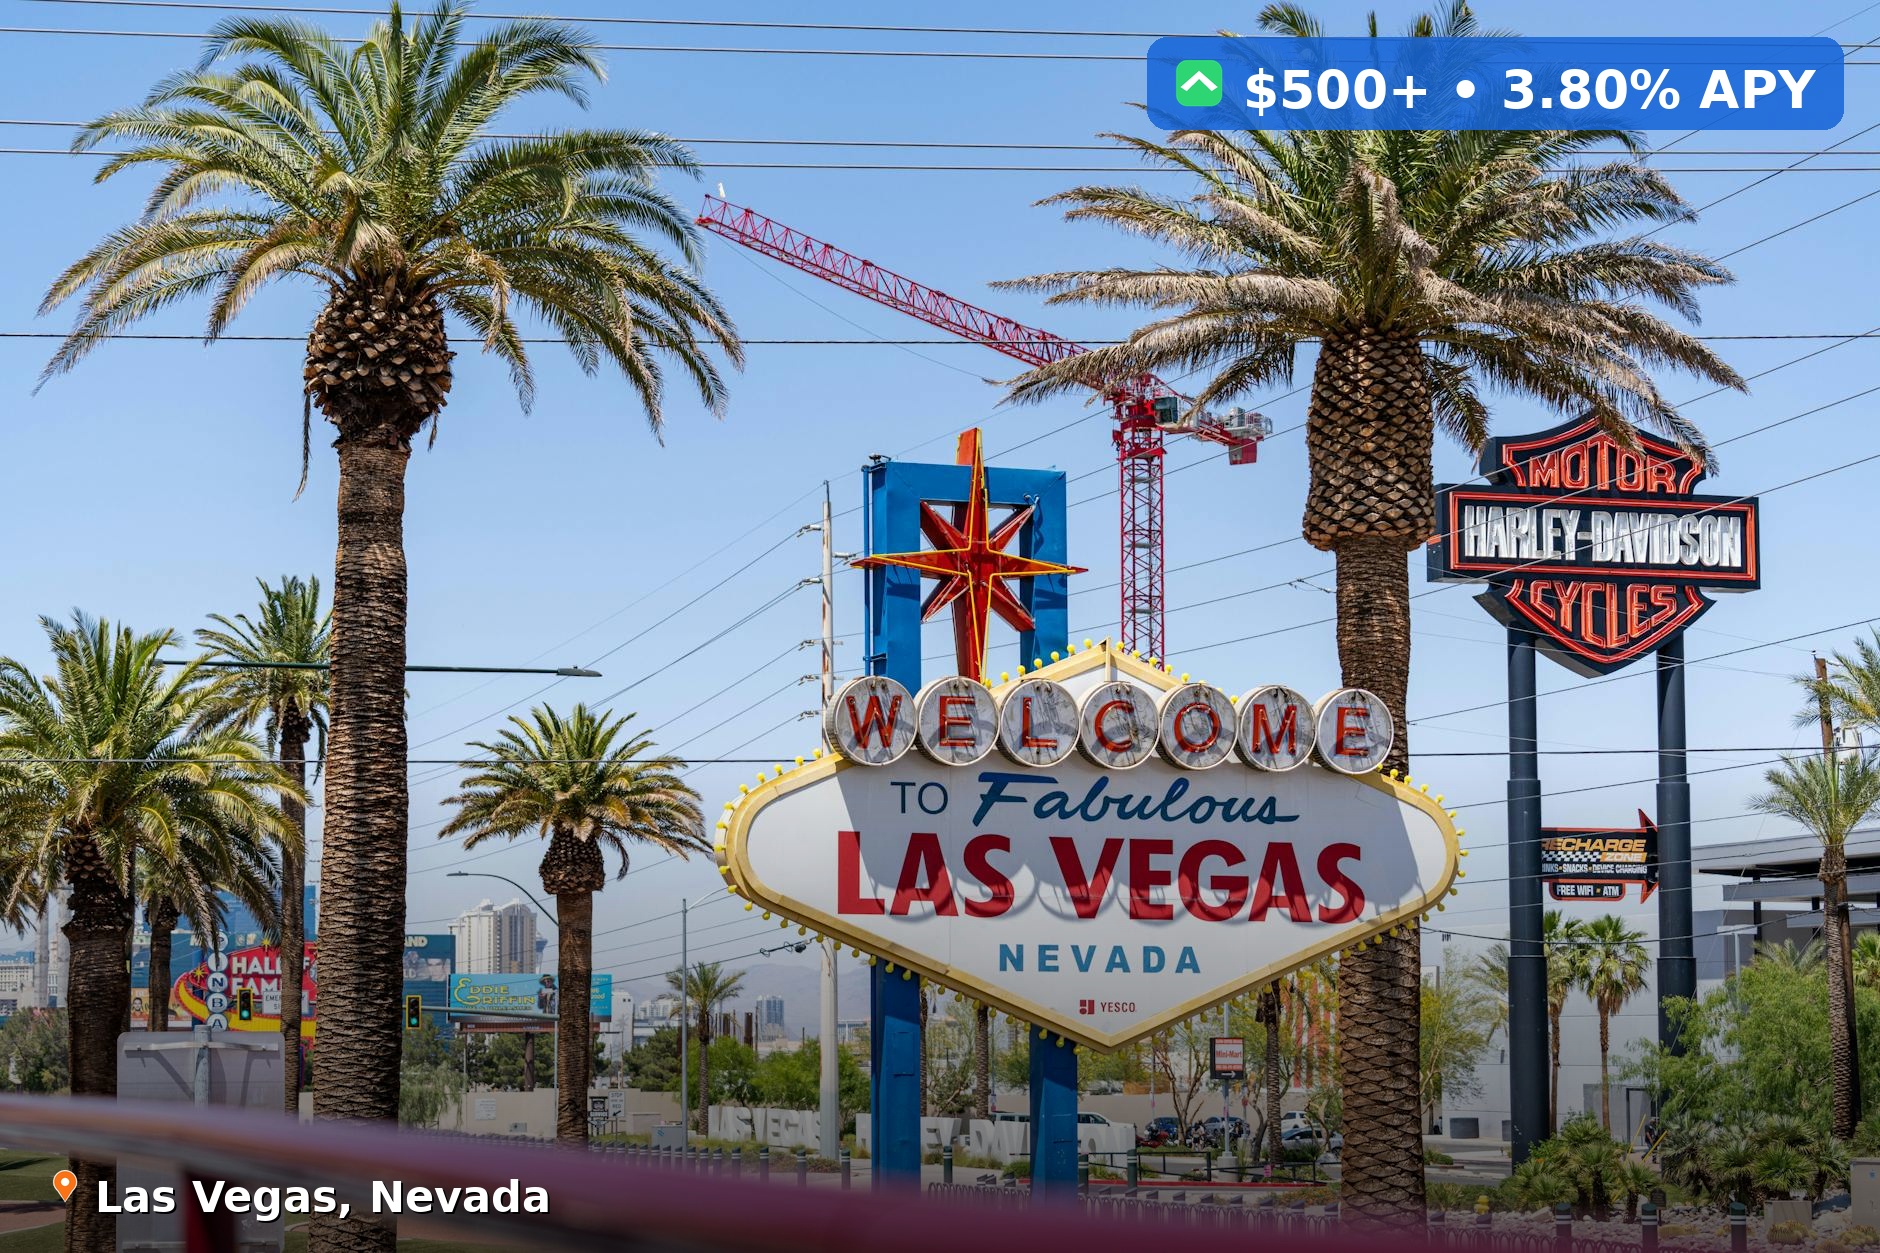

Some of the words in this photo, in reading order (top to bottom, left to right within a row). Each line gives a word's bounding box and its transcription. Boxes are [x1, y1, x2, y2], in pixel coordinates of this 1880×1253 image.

[1528, 434, 1677, 494] MOTOR
[1464, 505, 1742, 567] HARLEY-DAVIDSON
[1529, 579, 1677, 649] CYCLES
[845, 694, 1371, 757] WELCOME
[890, 781, 949, 814] TO
[972, 771, 1300, 827] Fabulous
[1541, 838, 1647, 852] RECHARGE
[1606, 852, 1643, 862] ZONE
[837, 830, 1016, 918] LAS
[1049, 836, 1366, 924] VEGAS
[1542, 863, 1558, 873] INKS
[1562, 863, 1588, 873] SNACKS
[1592, 864, 1615, 874] DEVICE
[1616, 864, 1648, 874] CHARGING
[1556, 884, 1576, 896] FREE
[1577, 885, 1594, 896] WIFI
[1602, 885, 1620, 896] ATM
[999, 943, 1201, 974] NEVADA
[231, 977, 283, 996] FAM
[454, 977, 510, 996] EDDIE
[456, 992, 535, 1005] GRIFFIN
[1100, 1001, 1136, 1013] YESCO
